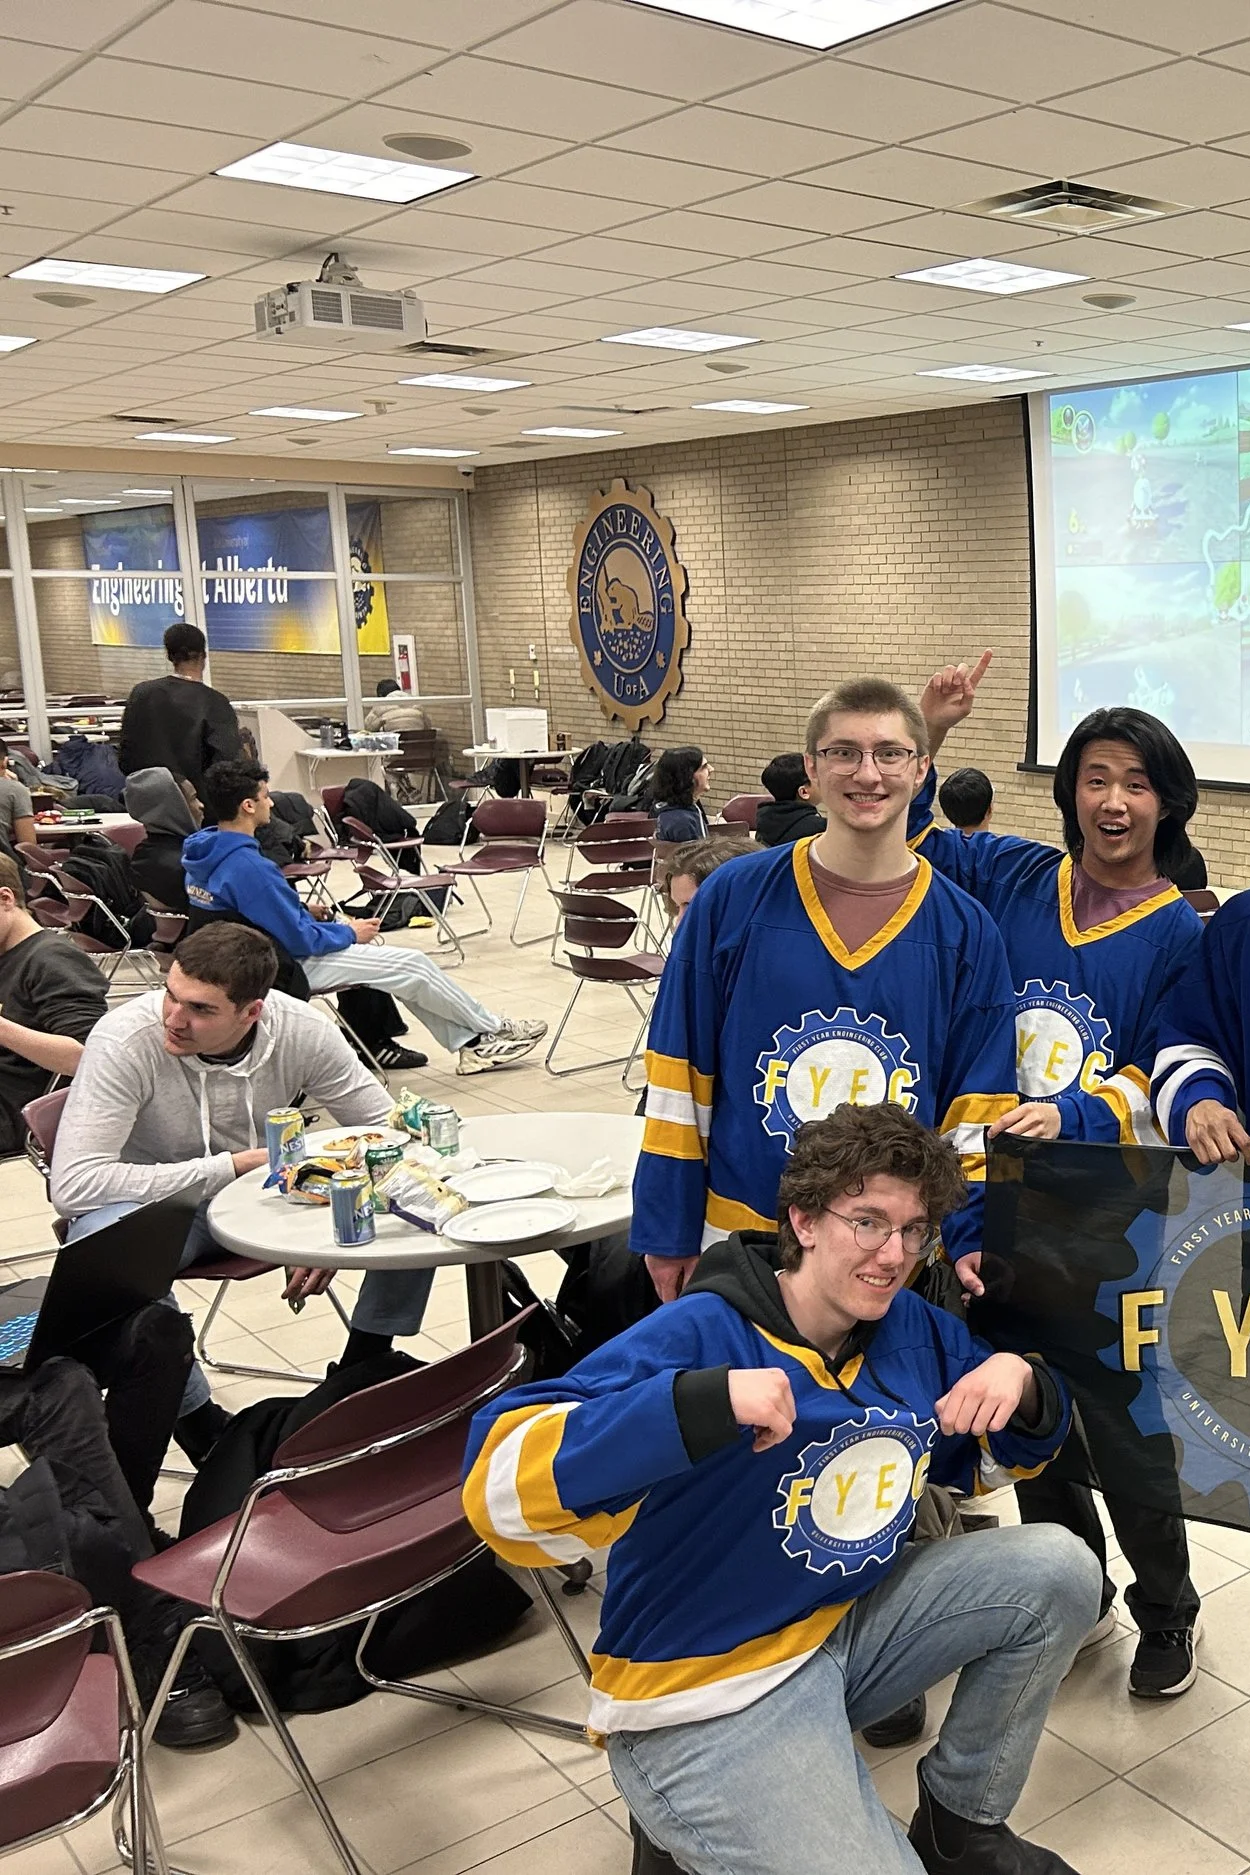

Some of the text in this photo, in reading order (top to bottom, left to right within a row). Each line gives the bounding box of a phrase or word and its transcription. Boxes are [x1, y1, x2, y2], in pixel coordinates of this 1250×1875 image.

[91, 559, 184, 616] Engineering
[214, 555, 288, 603] Alberta
[580, 508, 673, 615] ENGINEERING
[792, 1030, 888, 1060] FIRST YEAR ENGINEERING CLUB
[1016, 1028, 1107, 1094] YEC
[1170, 1225, 1210, 1266] FIRST
[818, 1447, 838, 1467] FIRST
[840, 1435, 859, 1449] YEAR
